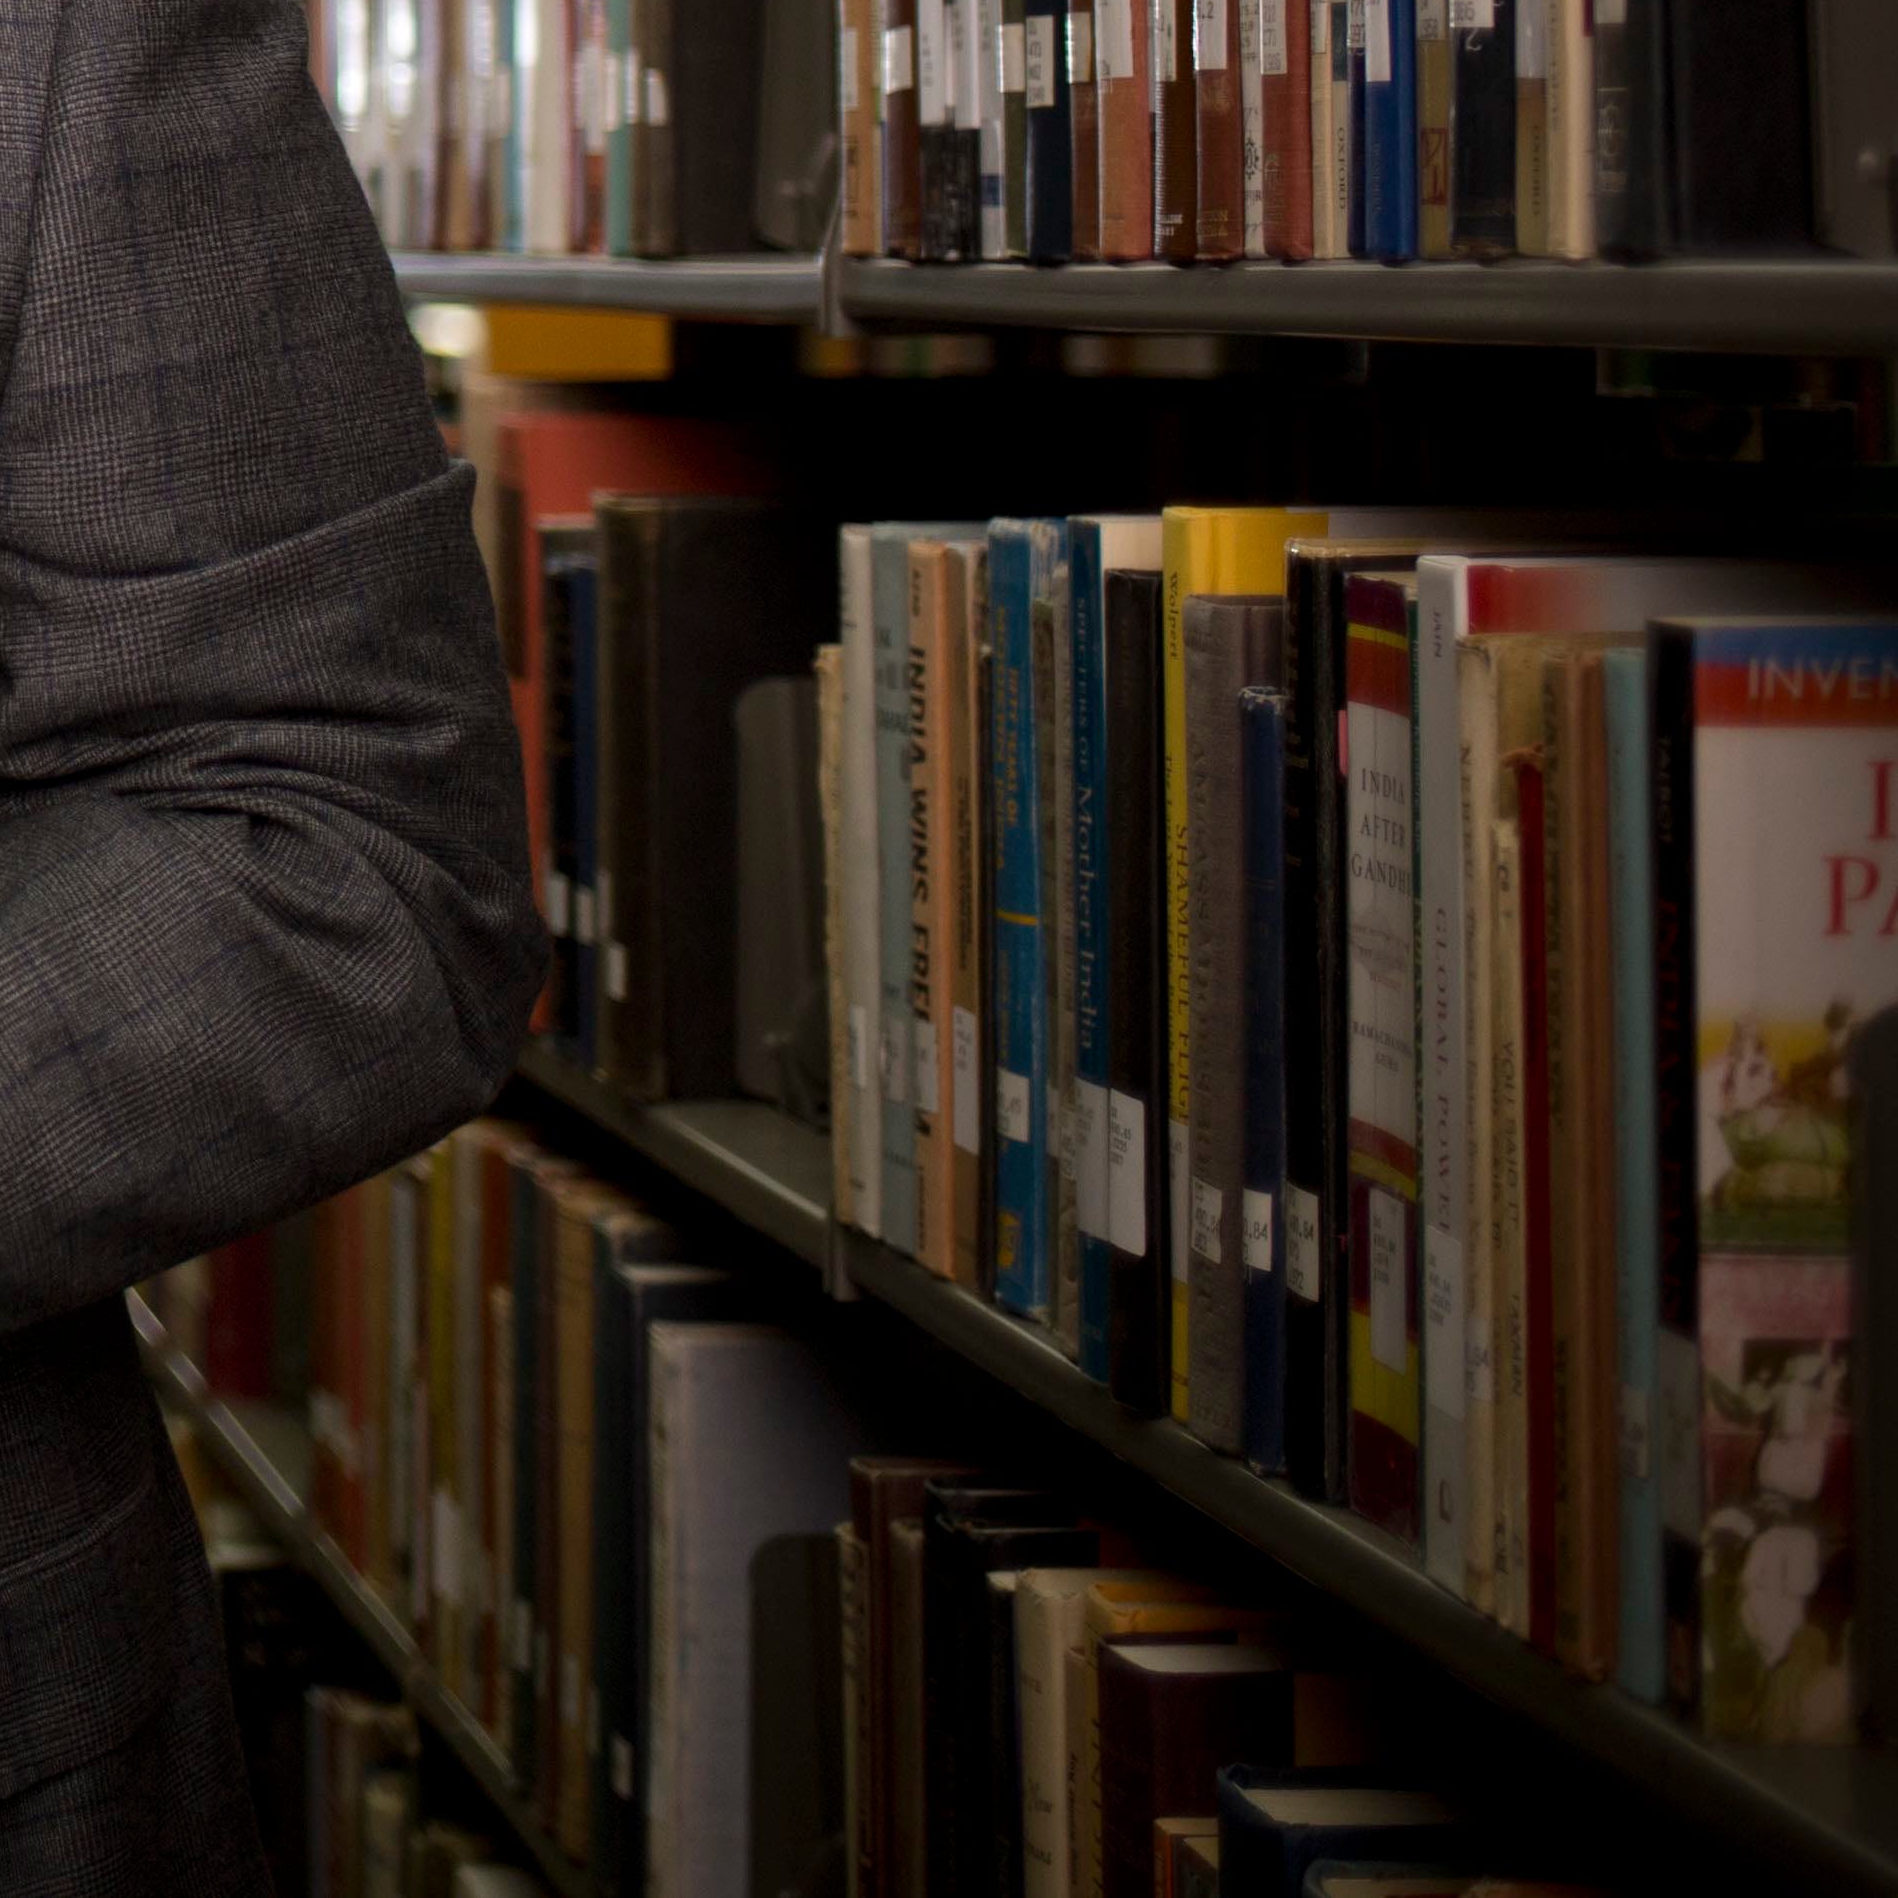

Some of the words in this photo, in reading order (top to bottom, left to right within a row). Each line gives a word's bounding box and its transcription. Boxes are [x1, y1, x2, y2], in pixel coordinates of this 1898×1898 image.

[1337, 127, 1347, 211] OXFORD
[1075, 596, 1088, 726] SPECTERS
[1166, 571, 1179, 660] Wolpert
[1430, 608, 1443, 659] JAIN
[908, 647, 927, 764] INDIA
[1076, 734, 1090, 773] OF
[1361, 768, 1405, 800] INDIA
[910, 787, 928, 904] WINS
[1076, 785, 1099, 927] Mother
[1460, 743, 1473, 879] NEHRU
[1174, 824, 1189, 1009] SHAMEFUL
[1078, 948, 1099, 1050] India
[1435, 907, 1449, 1079] GLOBAL
[1502, 1041, 1516, 1112] YOU
[1505, 1120, 1519, 1196] SAID
[1508, 1204, 1520, 1227] IT
